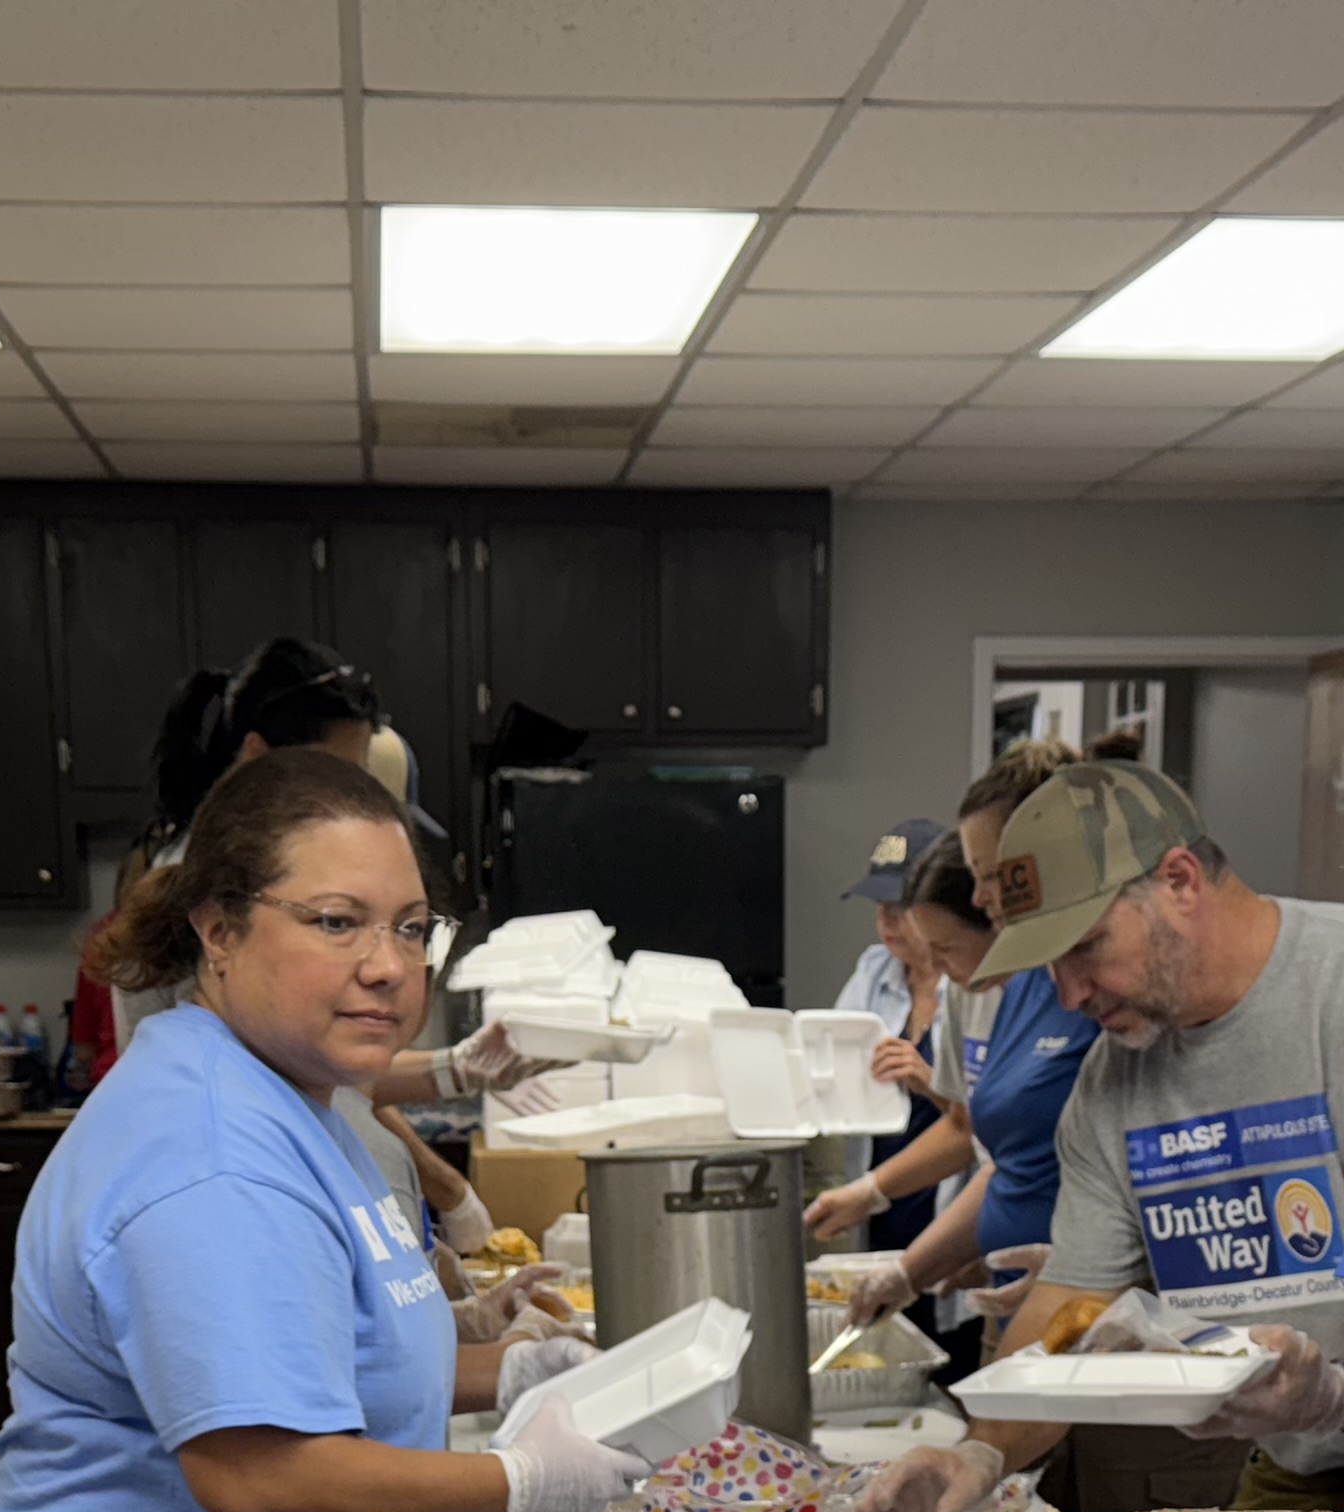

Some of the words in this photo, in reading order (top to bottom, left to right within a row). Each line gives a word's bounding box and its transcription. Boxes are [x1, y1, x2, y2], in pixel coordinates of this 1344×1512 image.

[1160, 1121, 1228, 1159] BASF
[1144, 1185, 1268, 1242] United
[1197, 1233, 1270, 1276] Way
